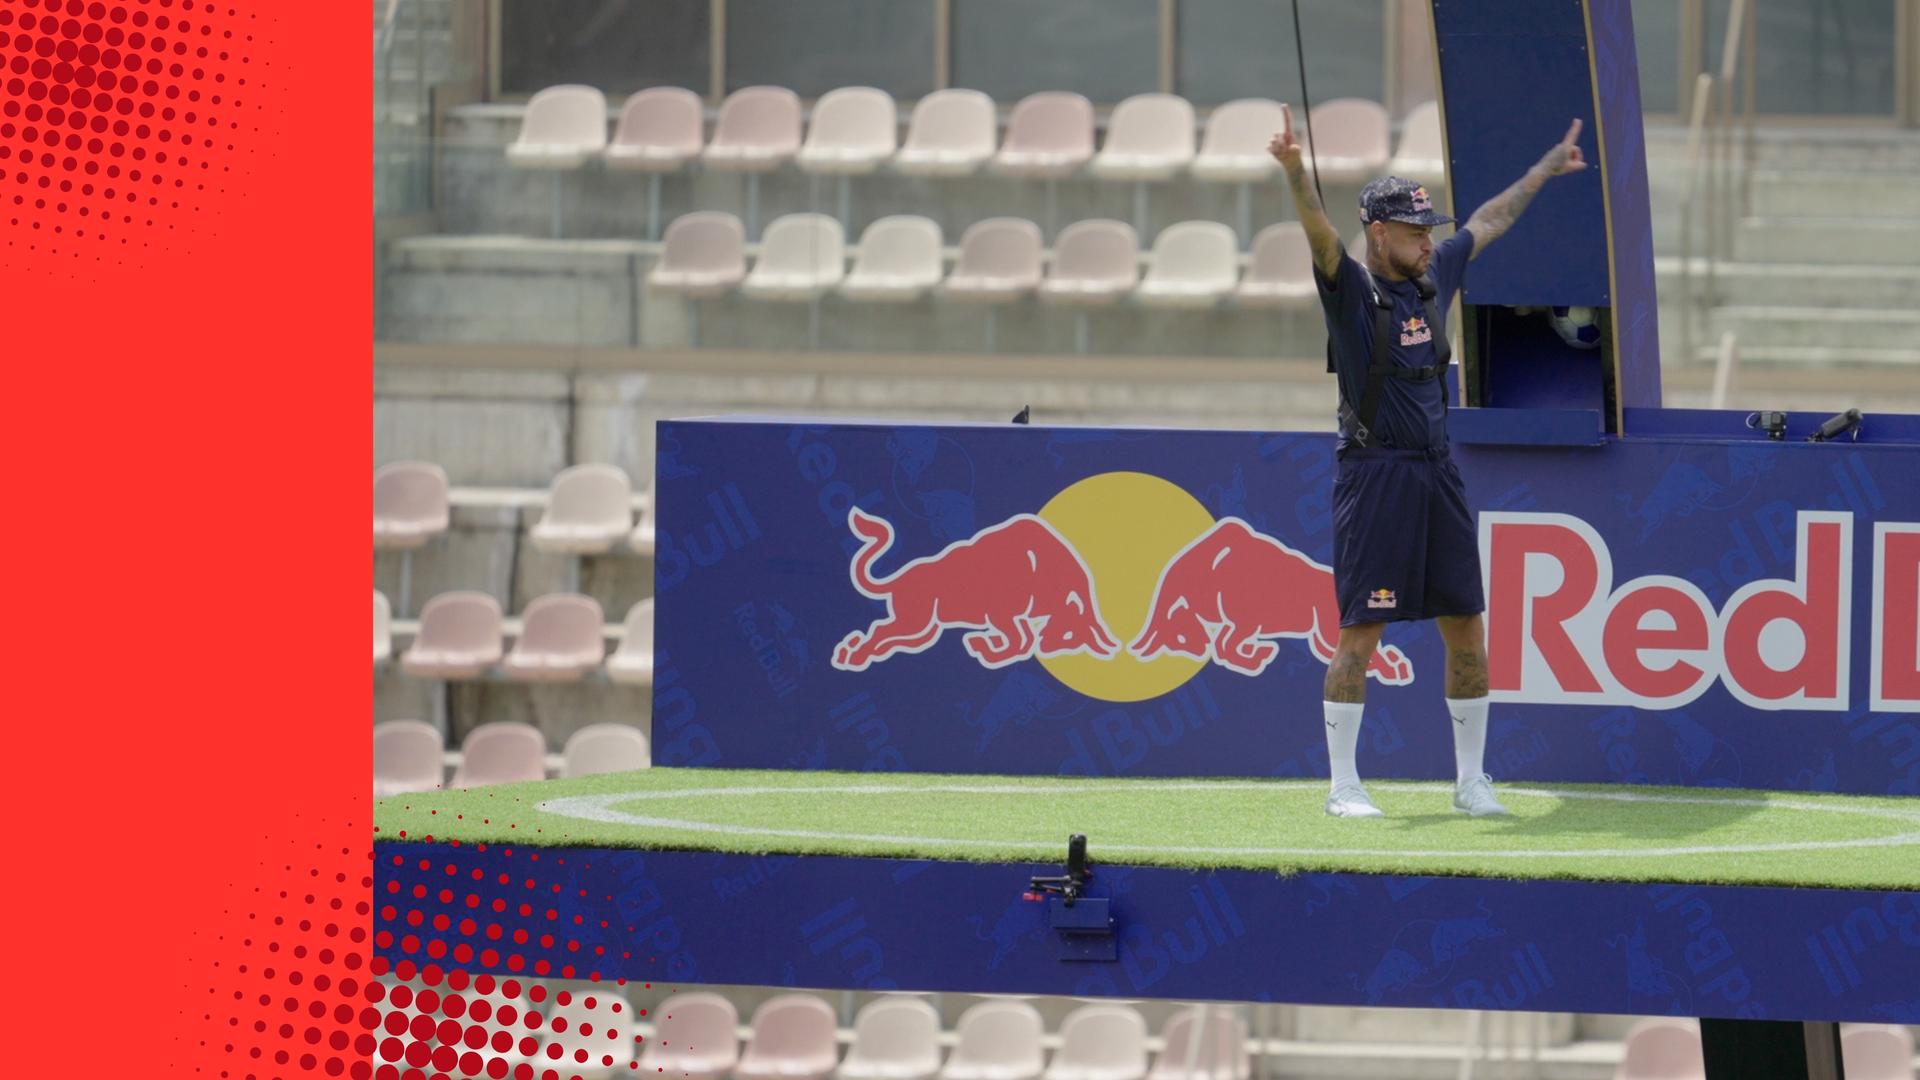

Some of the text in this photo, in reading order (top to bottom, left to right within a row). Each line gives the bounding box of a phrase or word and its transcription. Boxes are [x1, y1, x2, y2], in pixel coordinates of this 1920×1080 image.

[1479, 511, 1853, 711] Red
[1091, 674, 1222, 776] Bull
[1119, 876, 1247, 993] Bull
